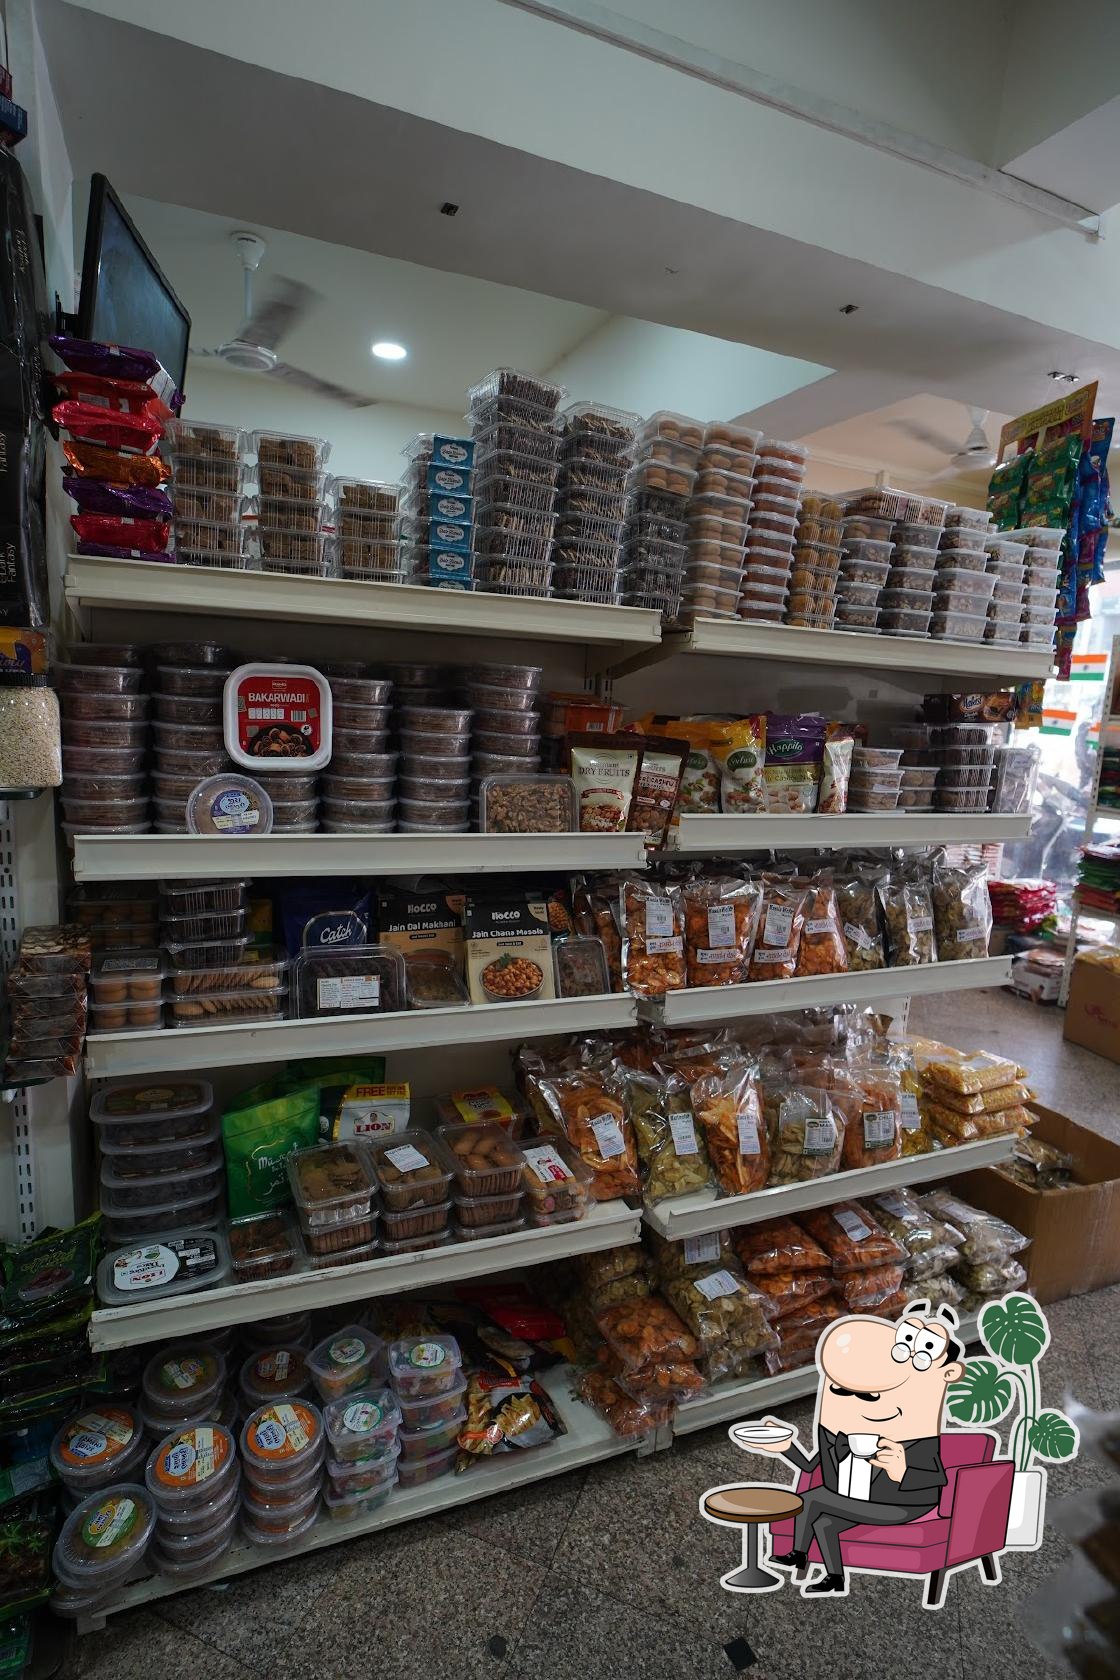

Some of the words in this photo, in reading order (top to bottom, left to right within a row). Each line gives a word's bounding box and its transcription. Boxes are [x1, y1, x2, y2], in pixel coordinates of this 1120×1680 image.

[7, 542, 17, 584] Fantasy
[248, 692, 305, 703] BAKARWADI
[768, 741, 803, 756] Happilo
[578, 767, 596, 775] DRY
[598, 768, 630, 777] FRUITS
[388, 924, 406, 932] Jain
[407, 922, 421, 931] Dal
[422, 919, 456, 930] Makhani
[320, 921, 353, 944] Catch
[472, 930, 489, 939] Jain
[490, 929, 515, 938] Chana
[516, 927, 544, 936] Masala
[356, 1086, 385, 1097] FREE
[355, 1122, 391, 1133] LION
